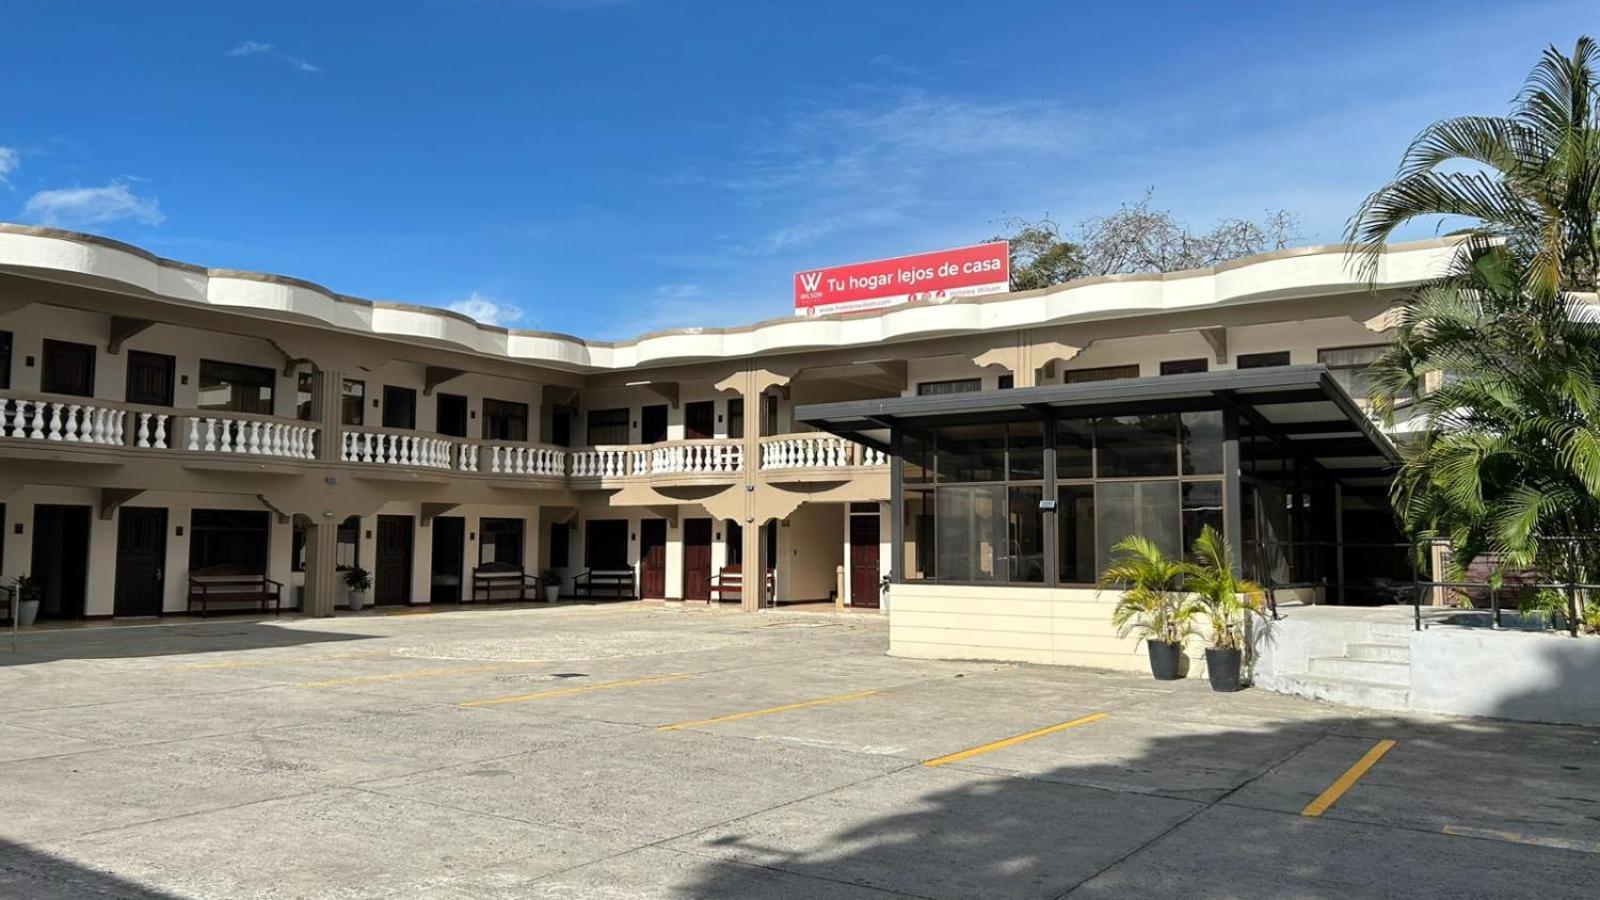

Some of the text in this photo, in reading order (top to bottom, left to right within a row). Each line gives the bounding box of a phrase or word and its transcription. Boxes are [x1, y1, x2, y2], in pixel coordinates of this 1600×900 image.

[827, 258, 1001, 293] Tu hogar lejos de casa
[976, 285, 1001, 293] Wilson
[800, 291, 823, 300] WILSON
